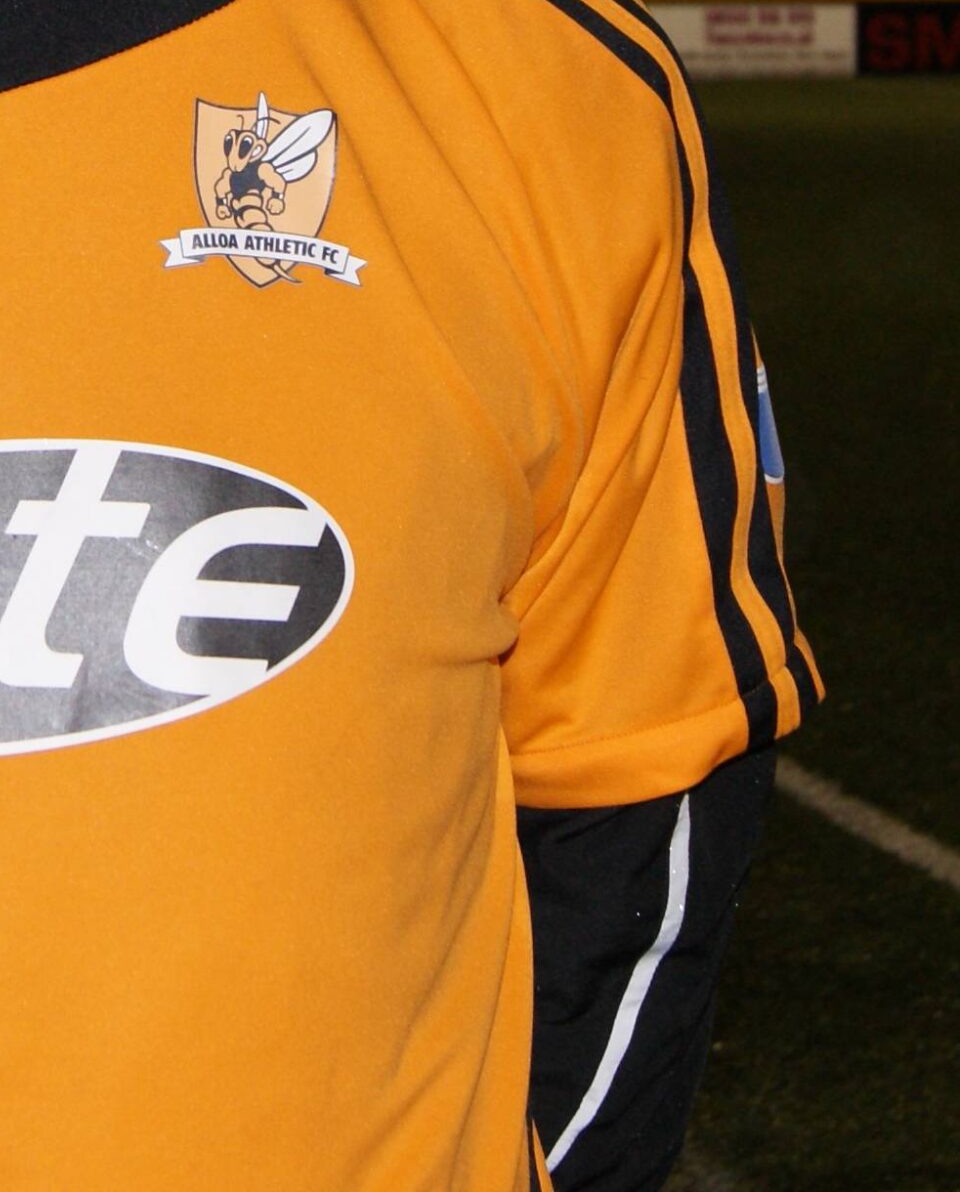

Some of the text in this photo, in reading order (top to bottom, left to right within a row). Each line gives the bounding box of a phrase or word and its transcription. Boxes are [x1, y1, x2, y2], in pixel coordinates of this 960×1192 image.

[192, 233, 339, 264] ALLOA ATHLETIC FC
